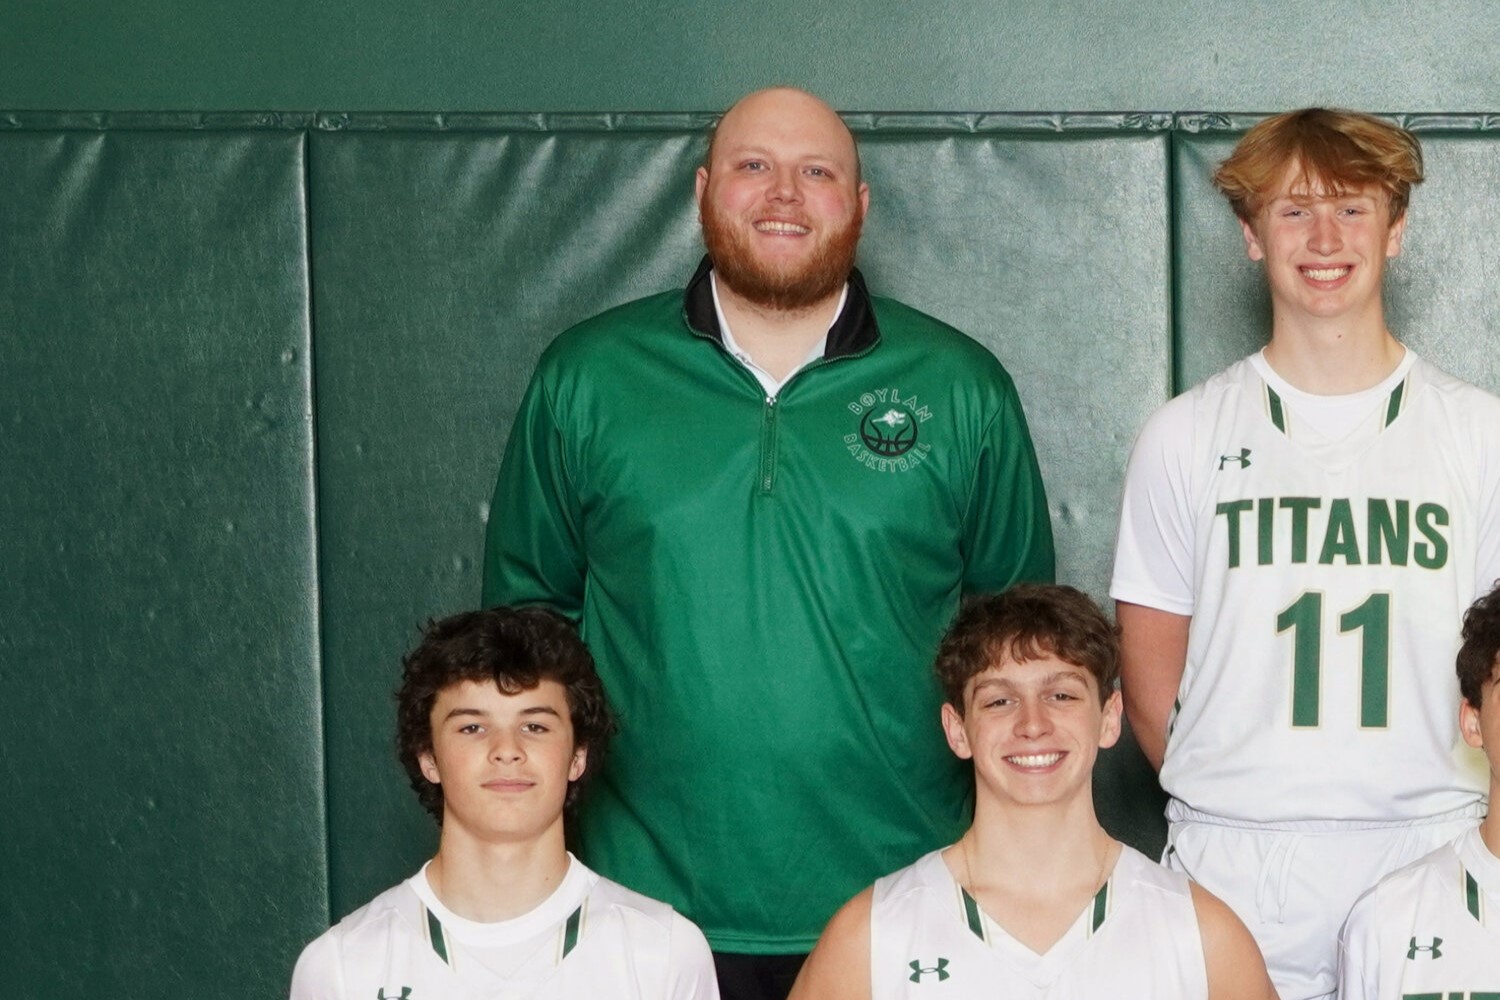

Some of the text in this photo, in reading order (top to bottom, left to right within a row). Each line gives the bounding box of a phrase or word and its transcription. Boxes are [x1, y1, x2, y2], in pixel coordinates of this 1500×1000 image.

[848, 388, 933, 423] BOYLAN
[844, 433, 931, 472] BASKETBALL
[1216, 496, 1449, 570] TITANS
[1275, 588, 1394, 731] 11
